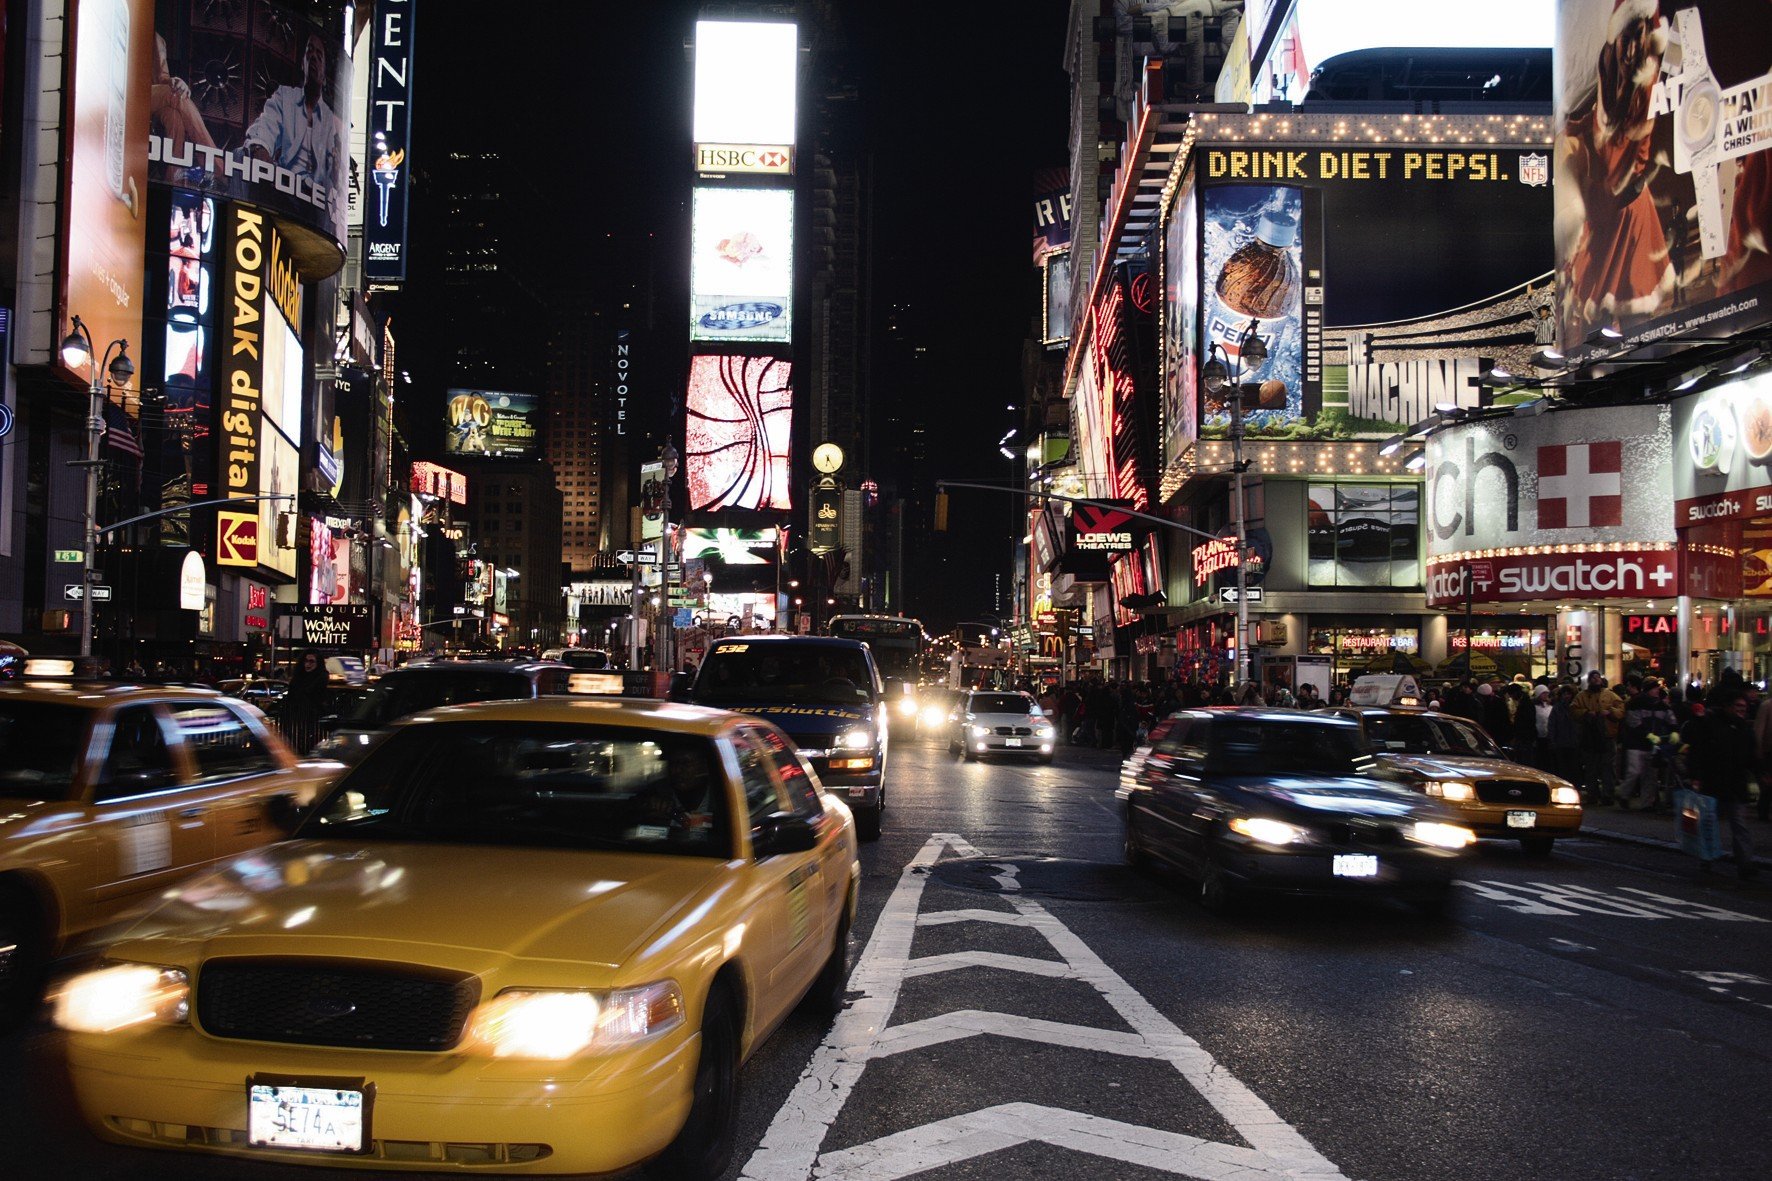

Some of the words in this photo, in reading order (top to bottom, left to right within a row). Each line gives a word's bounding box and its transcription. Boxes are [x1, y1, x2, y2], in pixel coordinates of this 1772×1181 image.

[376, 0, 407, 131] ENT
[700, 150, 755, 167] HSBC
[1209, 151, 1308, 179] DRINK
[1320, 152, 1391, 179] DIET
[1405, 153, 1508, 181] PEPSI.
[1523, 169, 1545, 181] NFL
[369, 242, 401, 254] ARGENT
[232, 209, 263, 361] KODAK
[271, 227, 303, 336] Kodak
[709, 310, 773, 322] SAMSUNG
[1684, 297, 1758, 329] www.swatch.com
[1346, 333, 1370, 364] THE
[617, 345, 629, 435] NOVOTEL
[1348, 357, 1482, 425] MACHINE
[223, 370, 260, 503] digital
[1427, 436, 1519, 541] ch
[1689, 499, 1732, 521] swatch
[231, 534, 257, 546] Kodak
[1076, 533, 1132, 543] LOEWS
[1192, 536, 1238, 571] PLANET
[1427, 566, 1474, 599] atch
[1499, 558, 1643, 593] swatch
[290, 606, 368, 614] MARQUIS
[304, 619, 350, 632] WOMAN
[306, 631, 347, 644] WHITE
[1342, 637, 1391, 647] RESTAURANT
[1397, 637, 1413, 647] BAR
[1452, 637, 1501, 647] RESAURANT
[716, 645, 749, 654] 532
